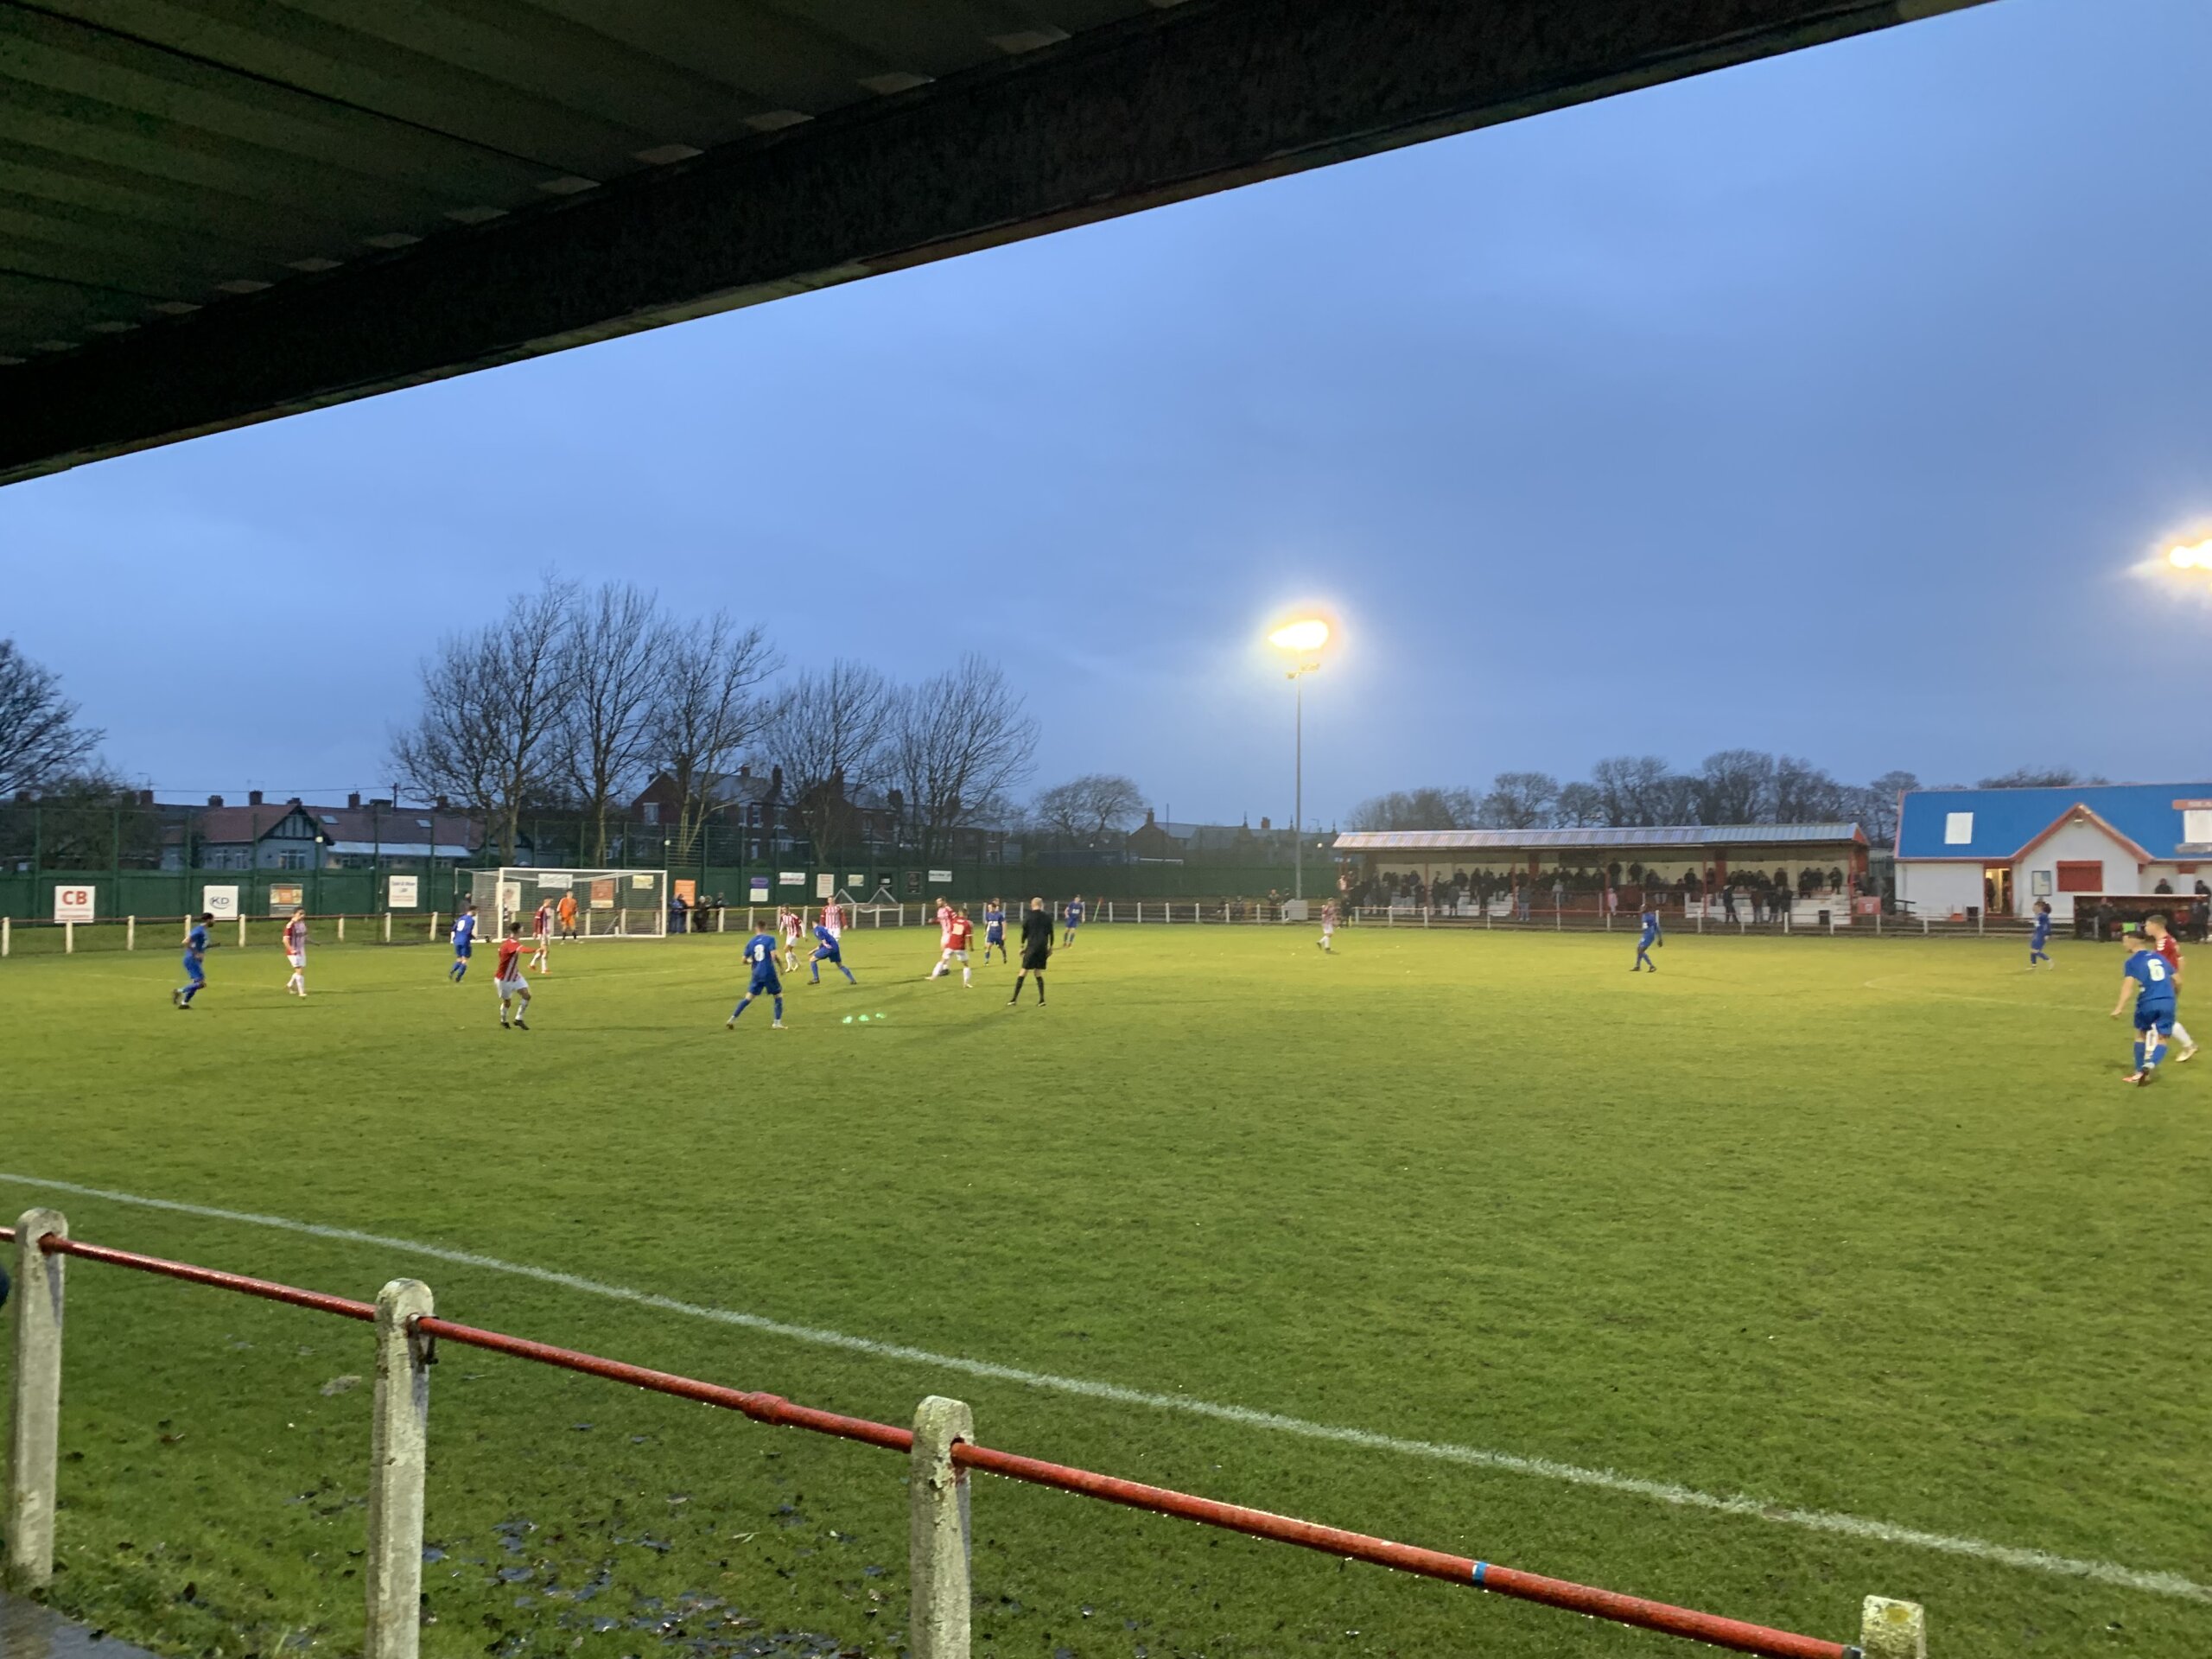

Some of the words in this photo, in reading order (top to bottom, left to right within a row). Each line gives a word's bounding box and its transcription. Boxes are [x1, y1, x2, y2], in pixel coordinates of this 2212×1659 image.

[62, 891, 87, 905] CB
[754, 944, 765, 962] 8
[2147, 958, 2165, 982] 6
